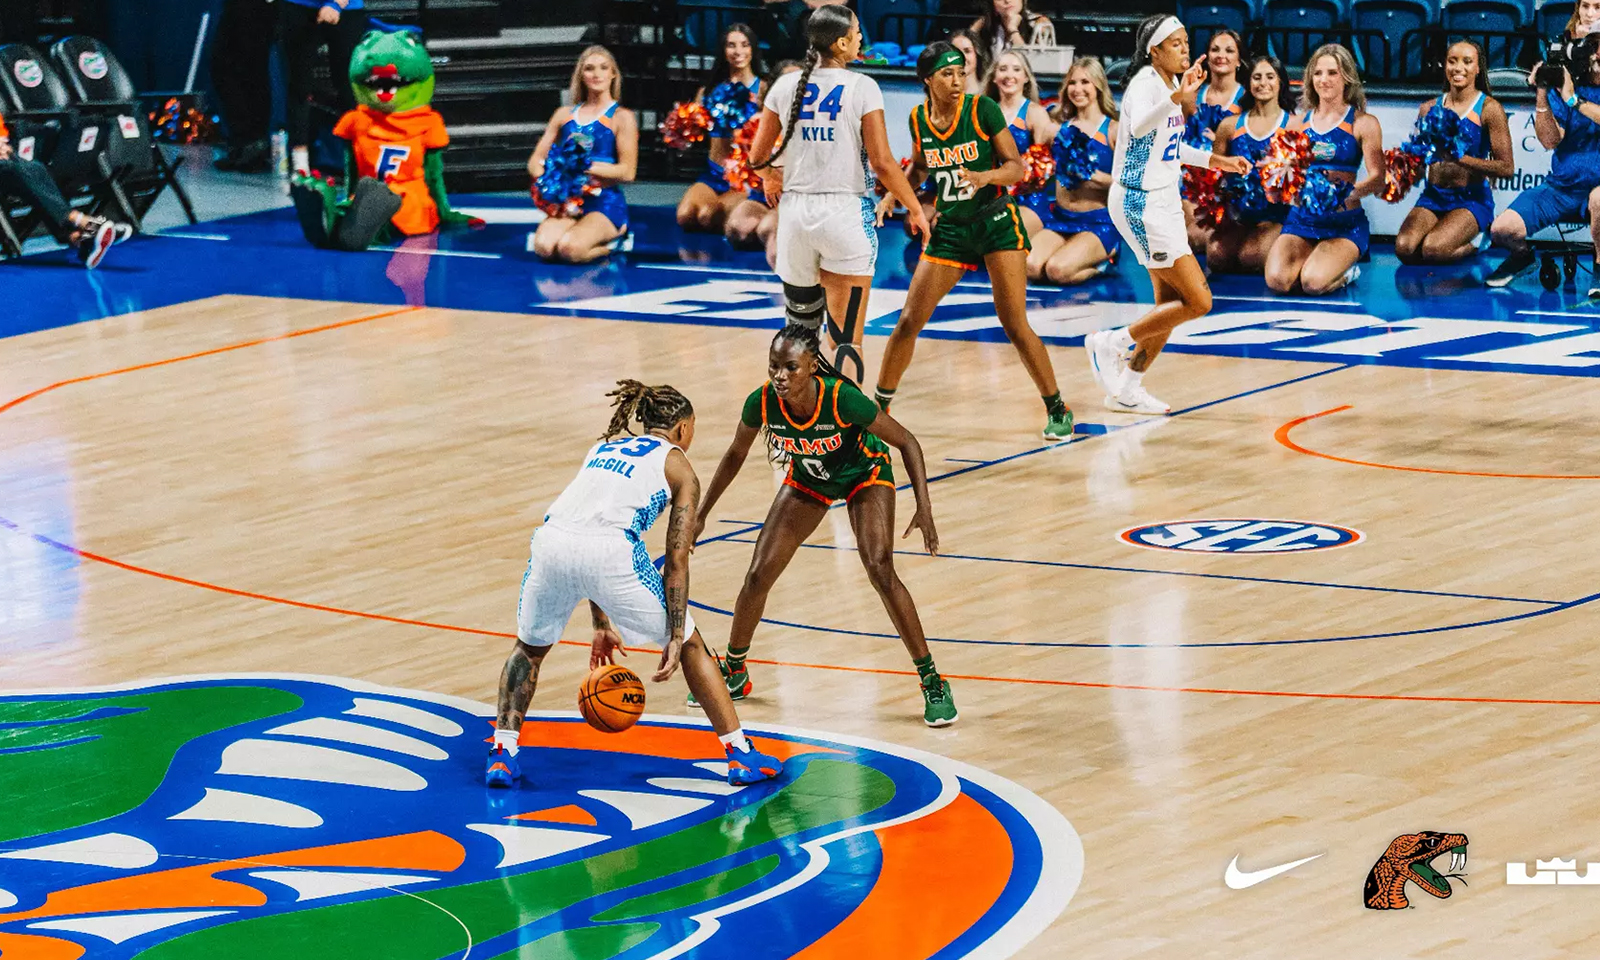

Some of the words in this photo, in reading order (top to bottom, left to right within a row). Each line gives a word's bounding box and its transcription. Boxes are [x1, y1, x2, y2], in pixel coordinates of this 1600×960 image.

[798, 82, 845, 121] 24
[802, 126, 834, 142] KYLE
[373, 144, 411, 173] F
[935, 168, 974, 202] 25
[596, 437, 661, 457] 23
[802, 458, 830, 481] 0
[1139, 520, 1342, 552] SEC
